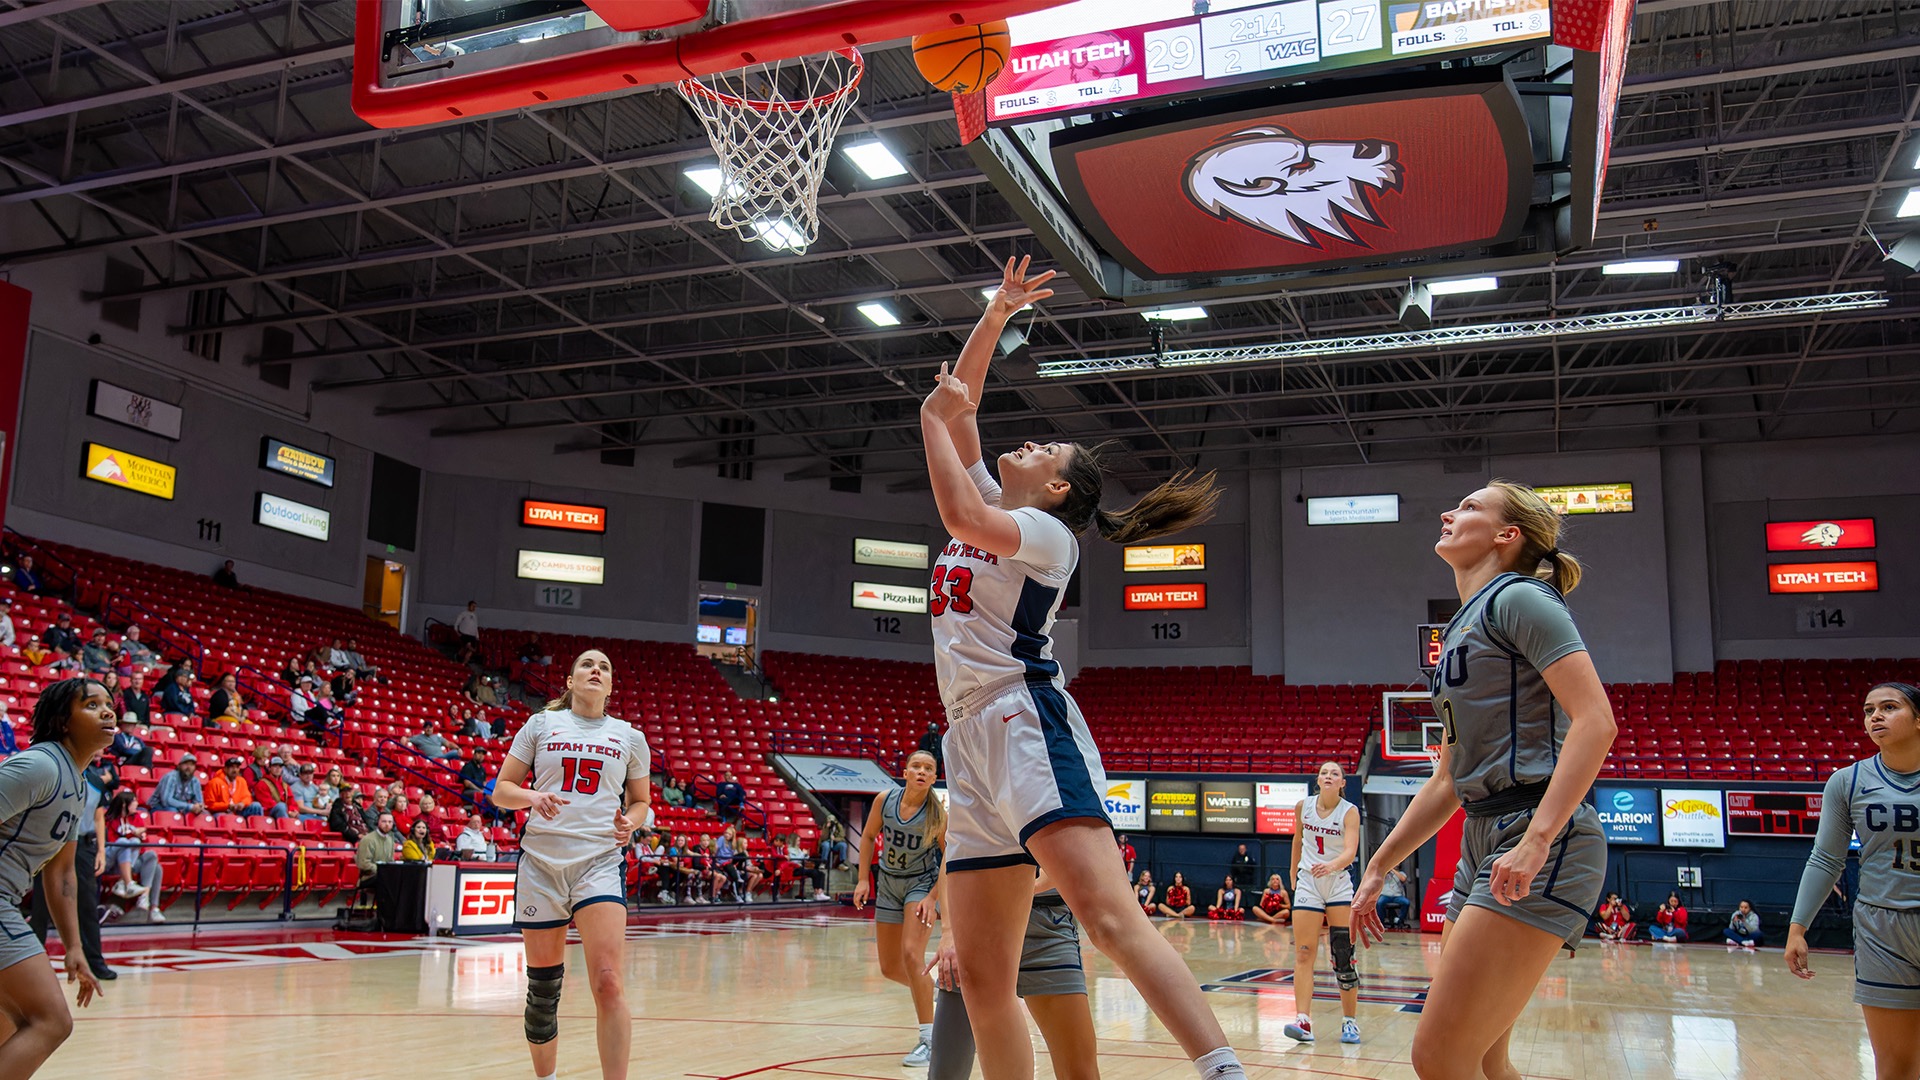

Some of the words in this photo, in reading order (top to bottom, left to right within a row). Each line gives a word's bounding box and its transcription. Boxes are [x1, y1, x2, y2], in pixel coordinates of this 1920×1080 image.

[1230, 12, 1285, 43] 2:14
[1327, 4, 1377, 46] 27
[1493, 21, 1523, 32] TOL:
[1529, 13, 1542, 31] 3
[1398, 32, 1446, 47] FOULS:
[1455, 26, 1468, 43] 2
[1011, 52, 1070, 74] UTAH
[1071, 40, 1130, 64] TECH
[1147, 35, 1195, 75] 29
[1265, 38, 1317, 61] WAC
[1225, 49, 1241, 73] 2
[1078, 86, 1103, 97] TOL:
[1109, 79, 1122, 95] 4
[1000, 96, 1039, 109] FOULS:
[127, 459, 172, 479] MOUNTAIN
[130, 471, 167, 488] AMERICA
[528, 507, 563, 521] UTAH
[565, 511, 599, 524] TECH
[1324, 507, 1380, 516] Intermountain
[197, 518, 221, 542] 111
[541, 561, 575, 570] CAMPUS
[576, 565, 602, 573] STORE
[1777, 572, 1819, 584] UTAH
[1822, 571, 1866, 583] TECH
[542, 587, 574, 606] 112
[883, 592, 907, 603] Pizza
[907, 594, 924, 604] Hut
[930, 565, 974, 617] 33
[1131, 592, 1163, 602] UTAH
[1165, 591, 1198, 602] TECH
[873, 616, 901, 634] 112
[1806, 609, 1846, 628] 114
[1151, 622, 1181, 639] 113
[547, 742, 583, 752] UTAH
[586, 744, 621, 760] TECH
[561, 757, 604, 795] 15
[1104, 799, 1141, 813] Star
[1207, 797, 1251, 807] WATTS
[1598, 812, 1653, 824] CLARION
[1865, 804, 1920, 832] CB
[884, 824, 922, 850] CBU
[1320, 827, 1342, 836] TECH
[1613, 824, 1637, 832] HOTEL
[1315, 835, 1325, 855] 1
[888, 848, 907, 869] 24
[461, 881, 515, 916] ESP
[1426, 913, 1447, 923] UTA
